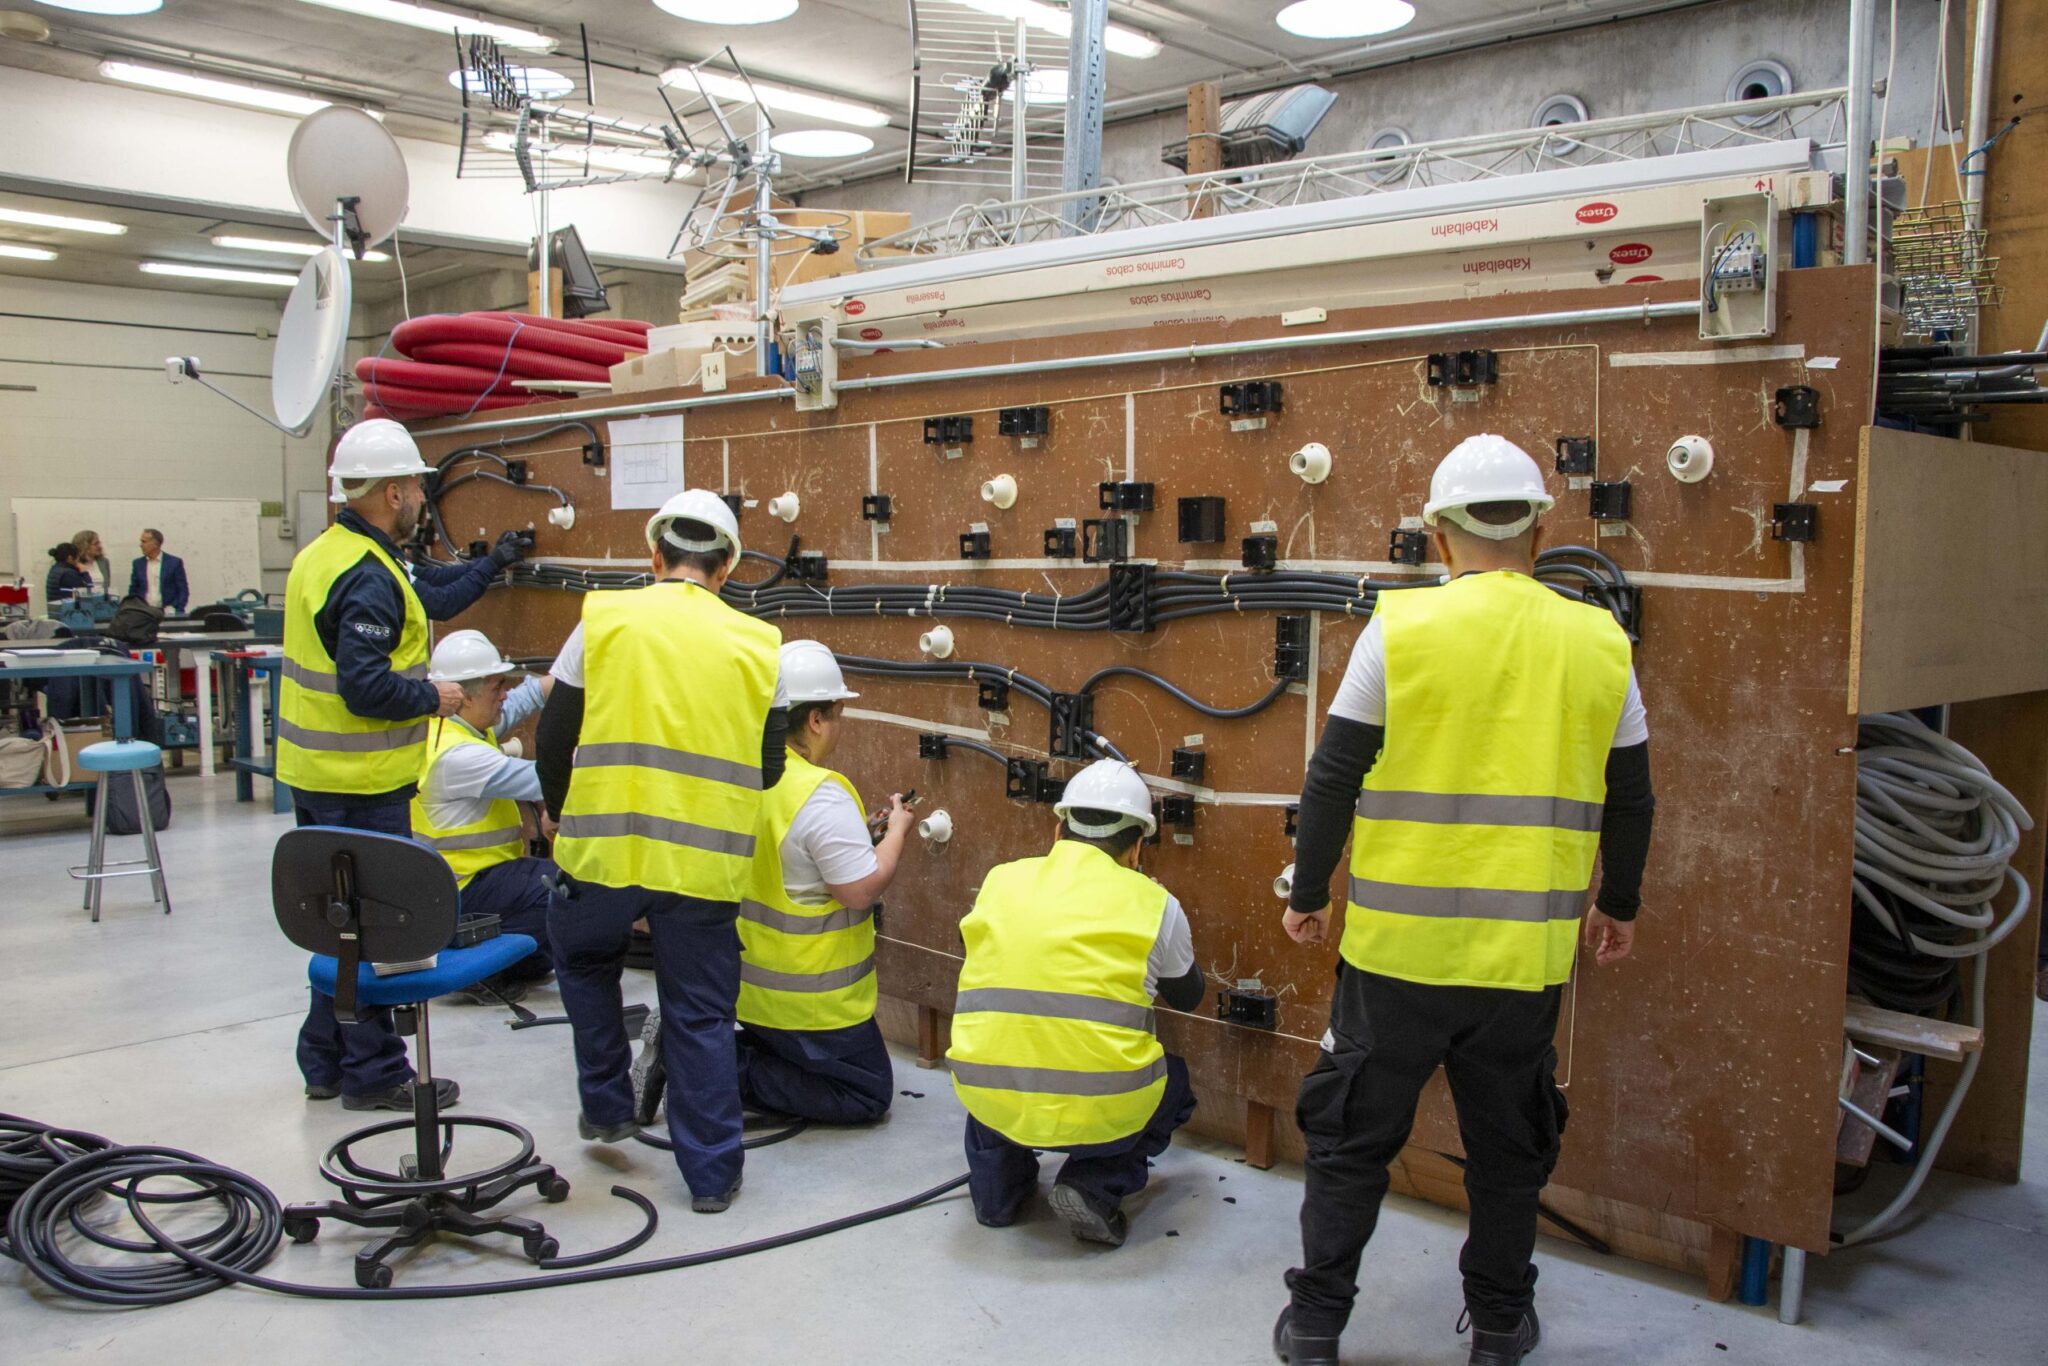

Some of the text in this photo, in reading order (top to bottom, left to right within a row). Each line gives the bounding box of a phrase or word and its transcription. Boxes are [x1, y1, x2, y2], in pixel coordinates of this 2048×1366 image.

[1578, 207, 1615, 218] Unex
[1431, 219, 1498, 237] Kabelbahn
[1612, 248, 1649, 259] Unex
[1106, 258, 1185, 277] Caminhos cabos
[1463, 257, 1531, 275] Kabelbahn
[906, 291, 945, 303] Passerella
[1130, 289, 1212, 307] Caminhos cabos
[923, 318, 965, 331] Passerella
[707, 364, 719, 377] 14
